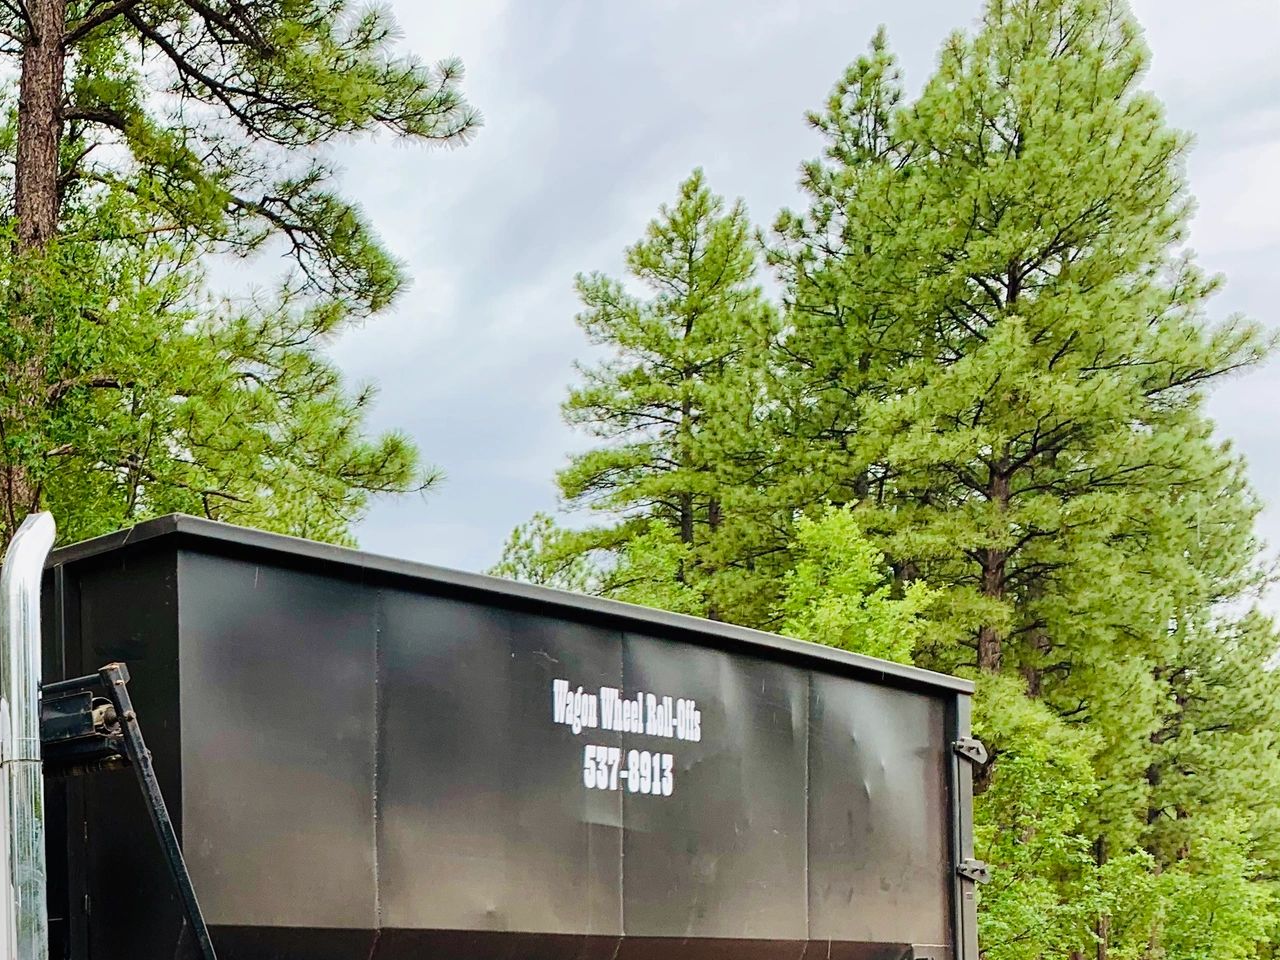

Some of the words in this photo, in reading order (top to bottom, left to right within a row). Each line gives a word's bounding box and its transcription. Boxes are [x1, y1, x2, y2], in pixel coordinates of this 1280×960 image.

[553, 678, 598, 735] Wagon
[600, 686, 644, 734] Wheel
[645, 692, 702, 743] Roll-Offs
[583, 744, 674, 797] 537-8913
